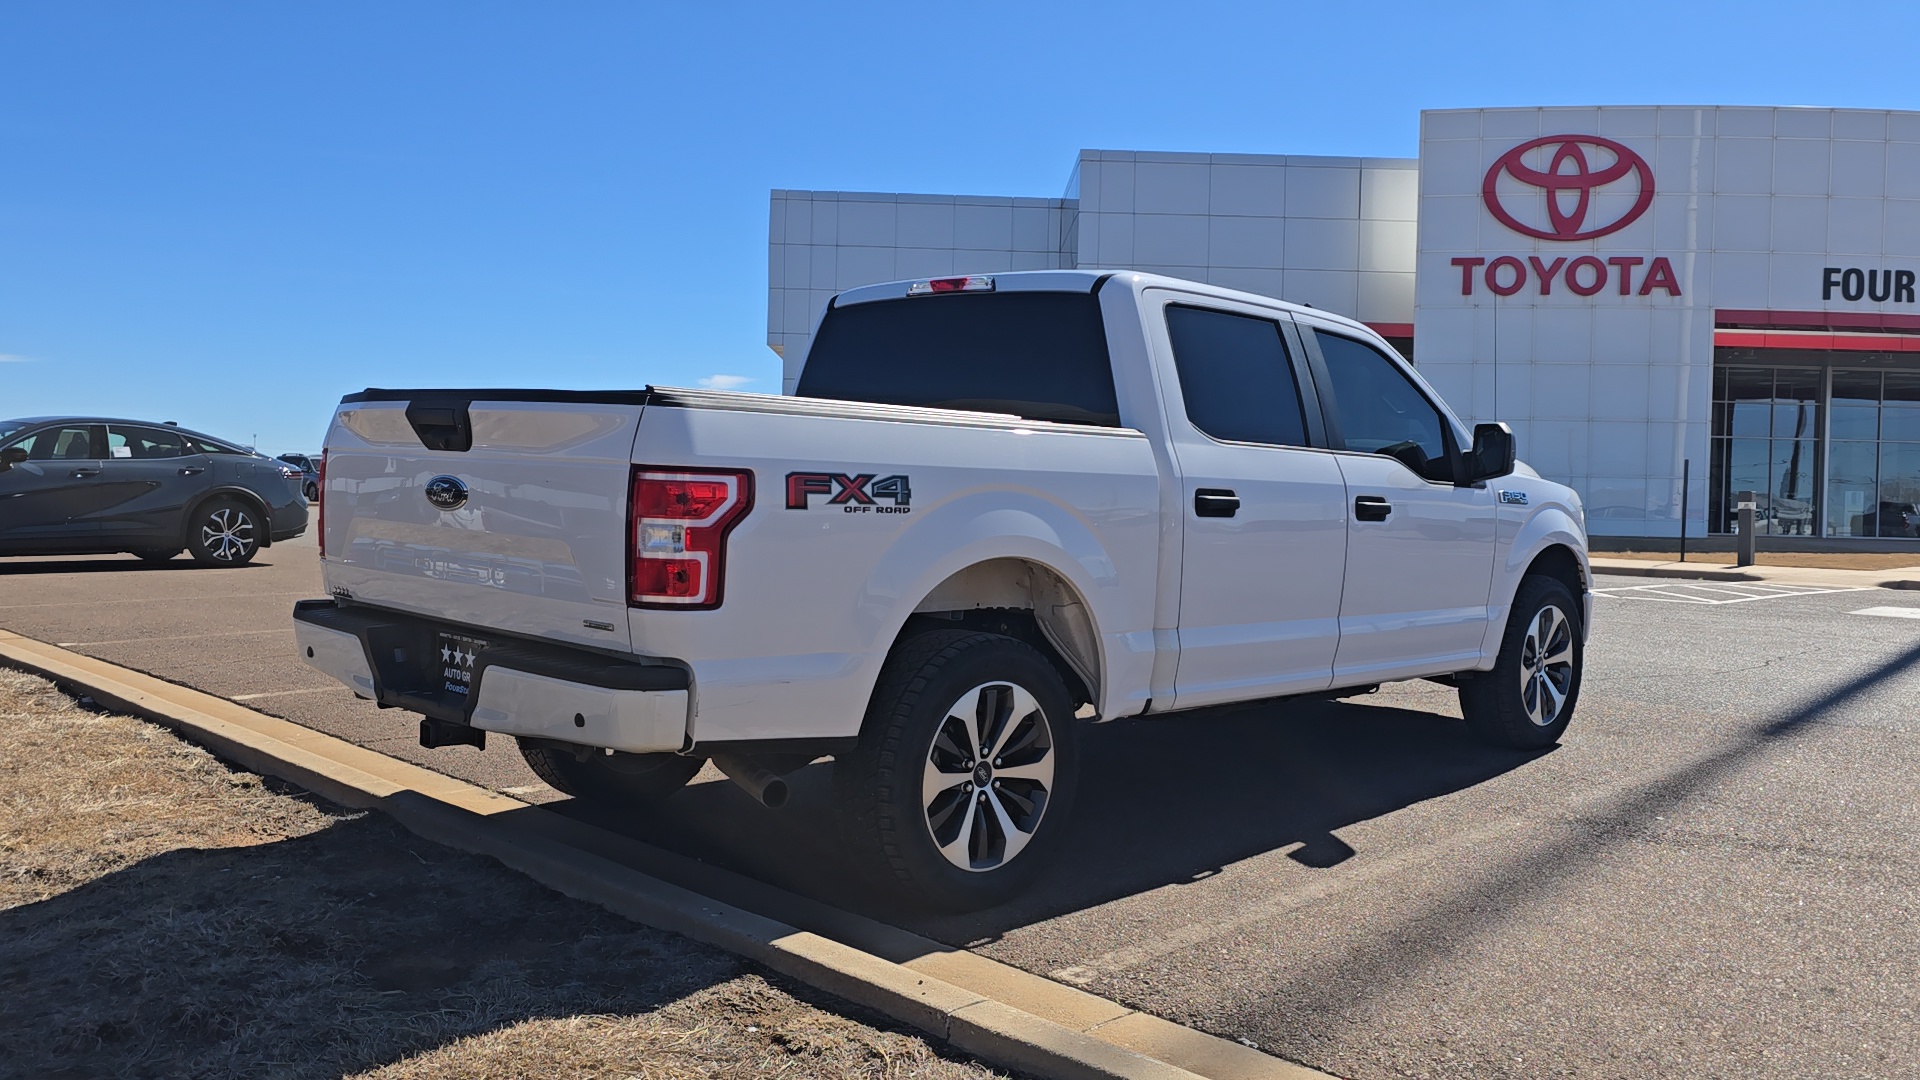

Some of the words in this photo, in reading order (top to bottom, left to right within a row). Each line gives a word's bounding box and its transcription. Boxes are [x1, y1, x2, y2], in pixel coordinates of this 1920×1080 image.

[1451, 255, 1682, 297] TOYOTA
[1822, 267, 1916, 303] FOUR
[785, 471, 911, 510] FX4
[875, 506, 911, 514] ROAD
[443, 667, 461, 680] AUTO
[462, 671, 471, 682] GR
